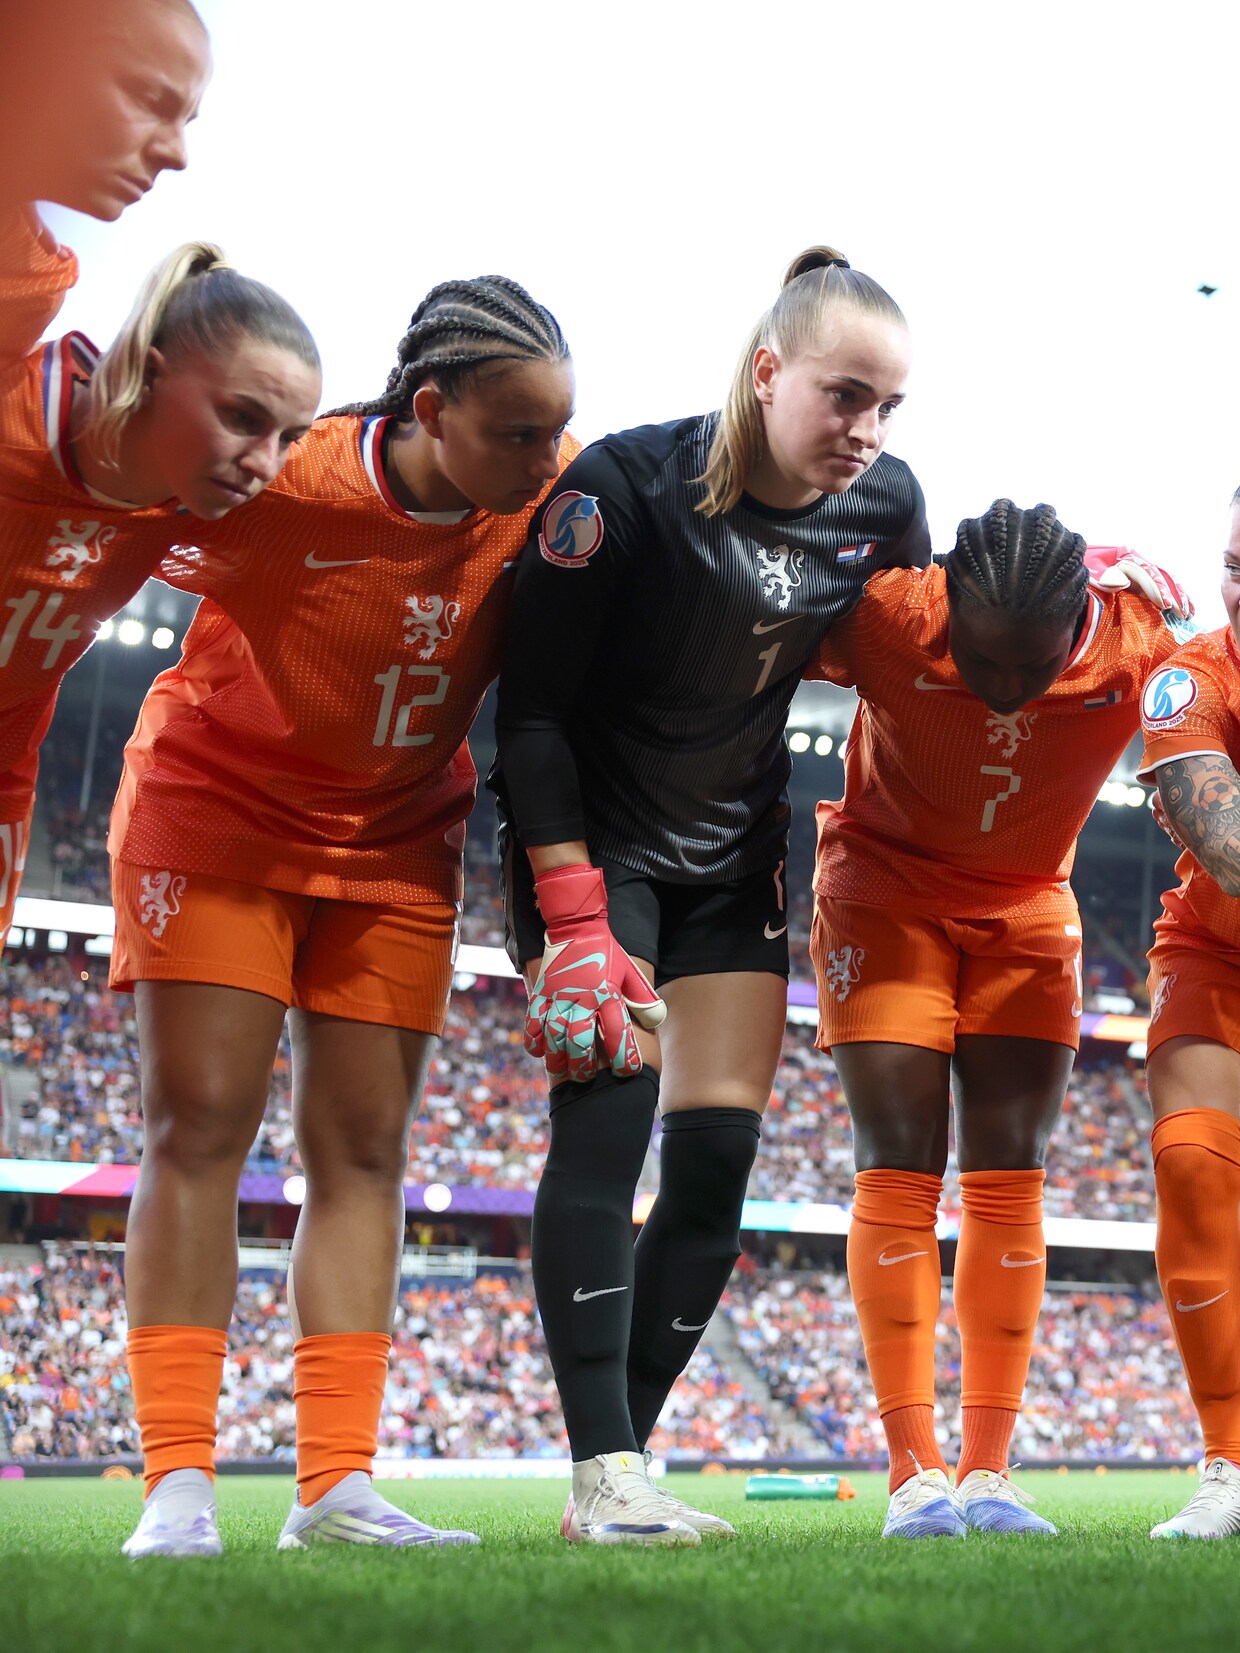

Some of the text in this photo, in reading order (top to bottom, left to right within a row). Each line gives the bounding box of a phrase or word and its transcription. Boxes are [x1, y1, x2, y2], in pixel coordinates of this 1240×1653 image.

[0, 589, 81, 670] 14
[372, 665, 451, 747] 12
[751, 642, 783, 698] 1
[980, 765, 1021, 832] 7
